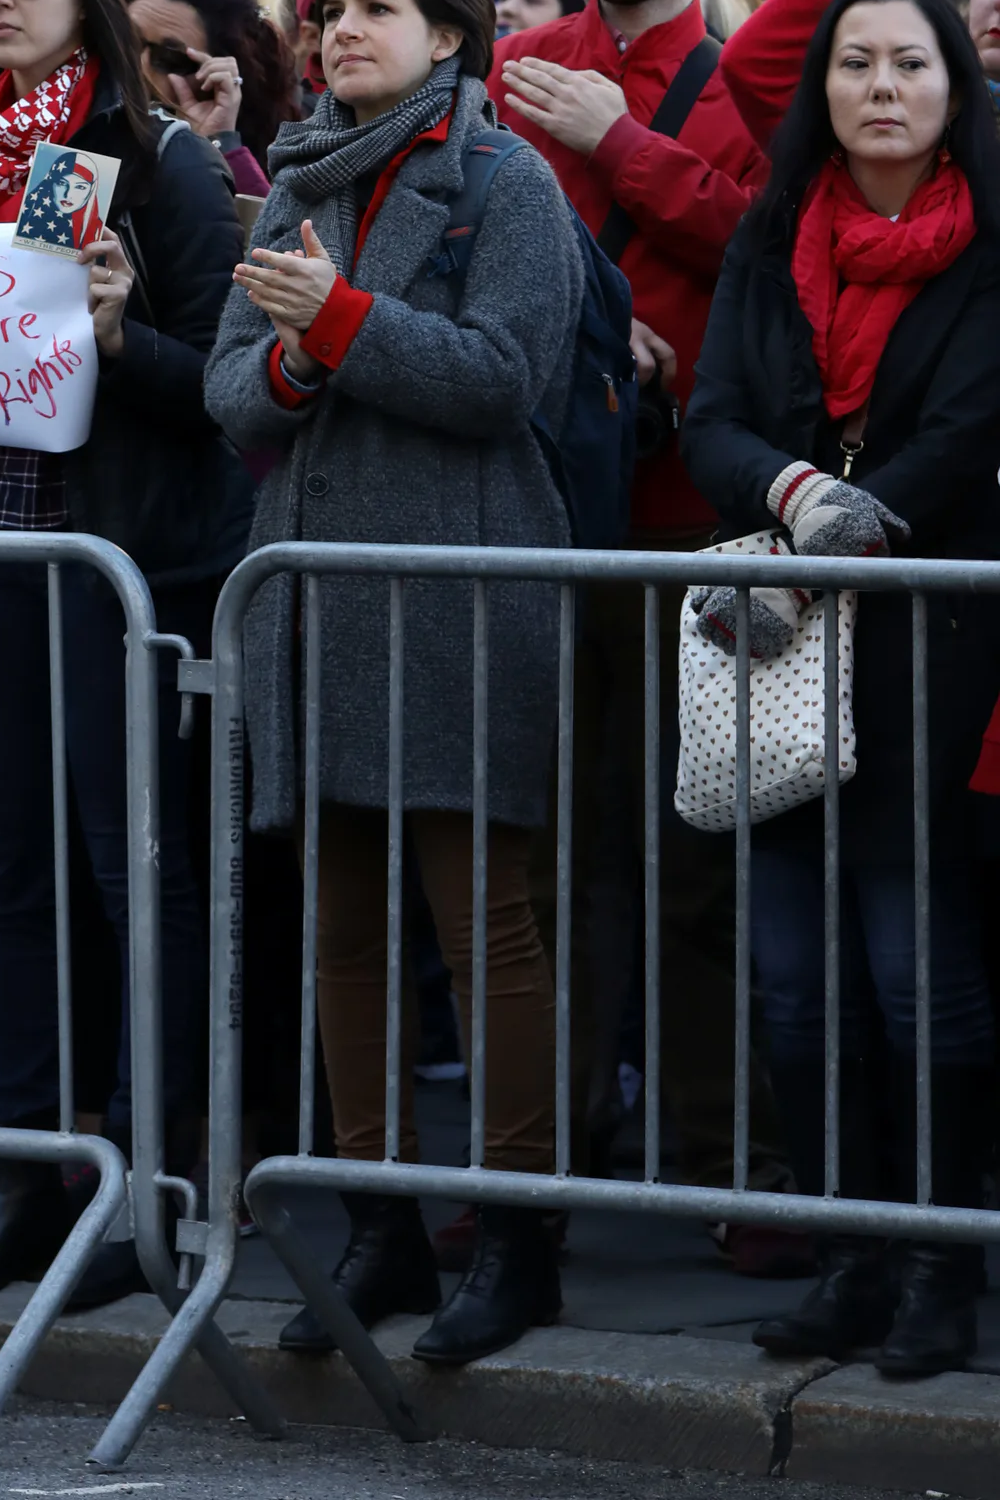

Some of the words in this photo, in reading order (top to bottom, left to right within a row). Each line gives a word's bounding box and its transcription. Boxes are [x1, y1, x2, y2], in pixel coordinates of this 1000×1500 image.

[23, 240, 36, 248] WE
[39, 241, 54, 250] THE
[56, 246, 80, 256] PEOPL
